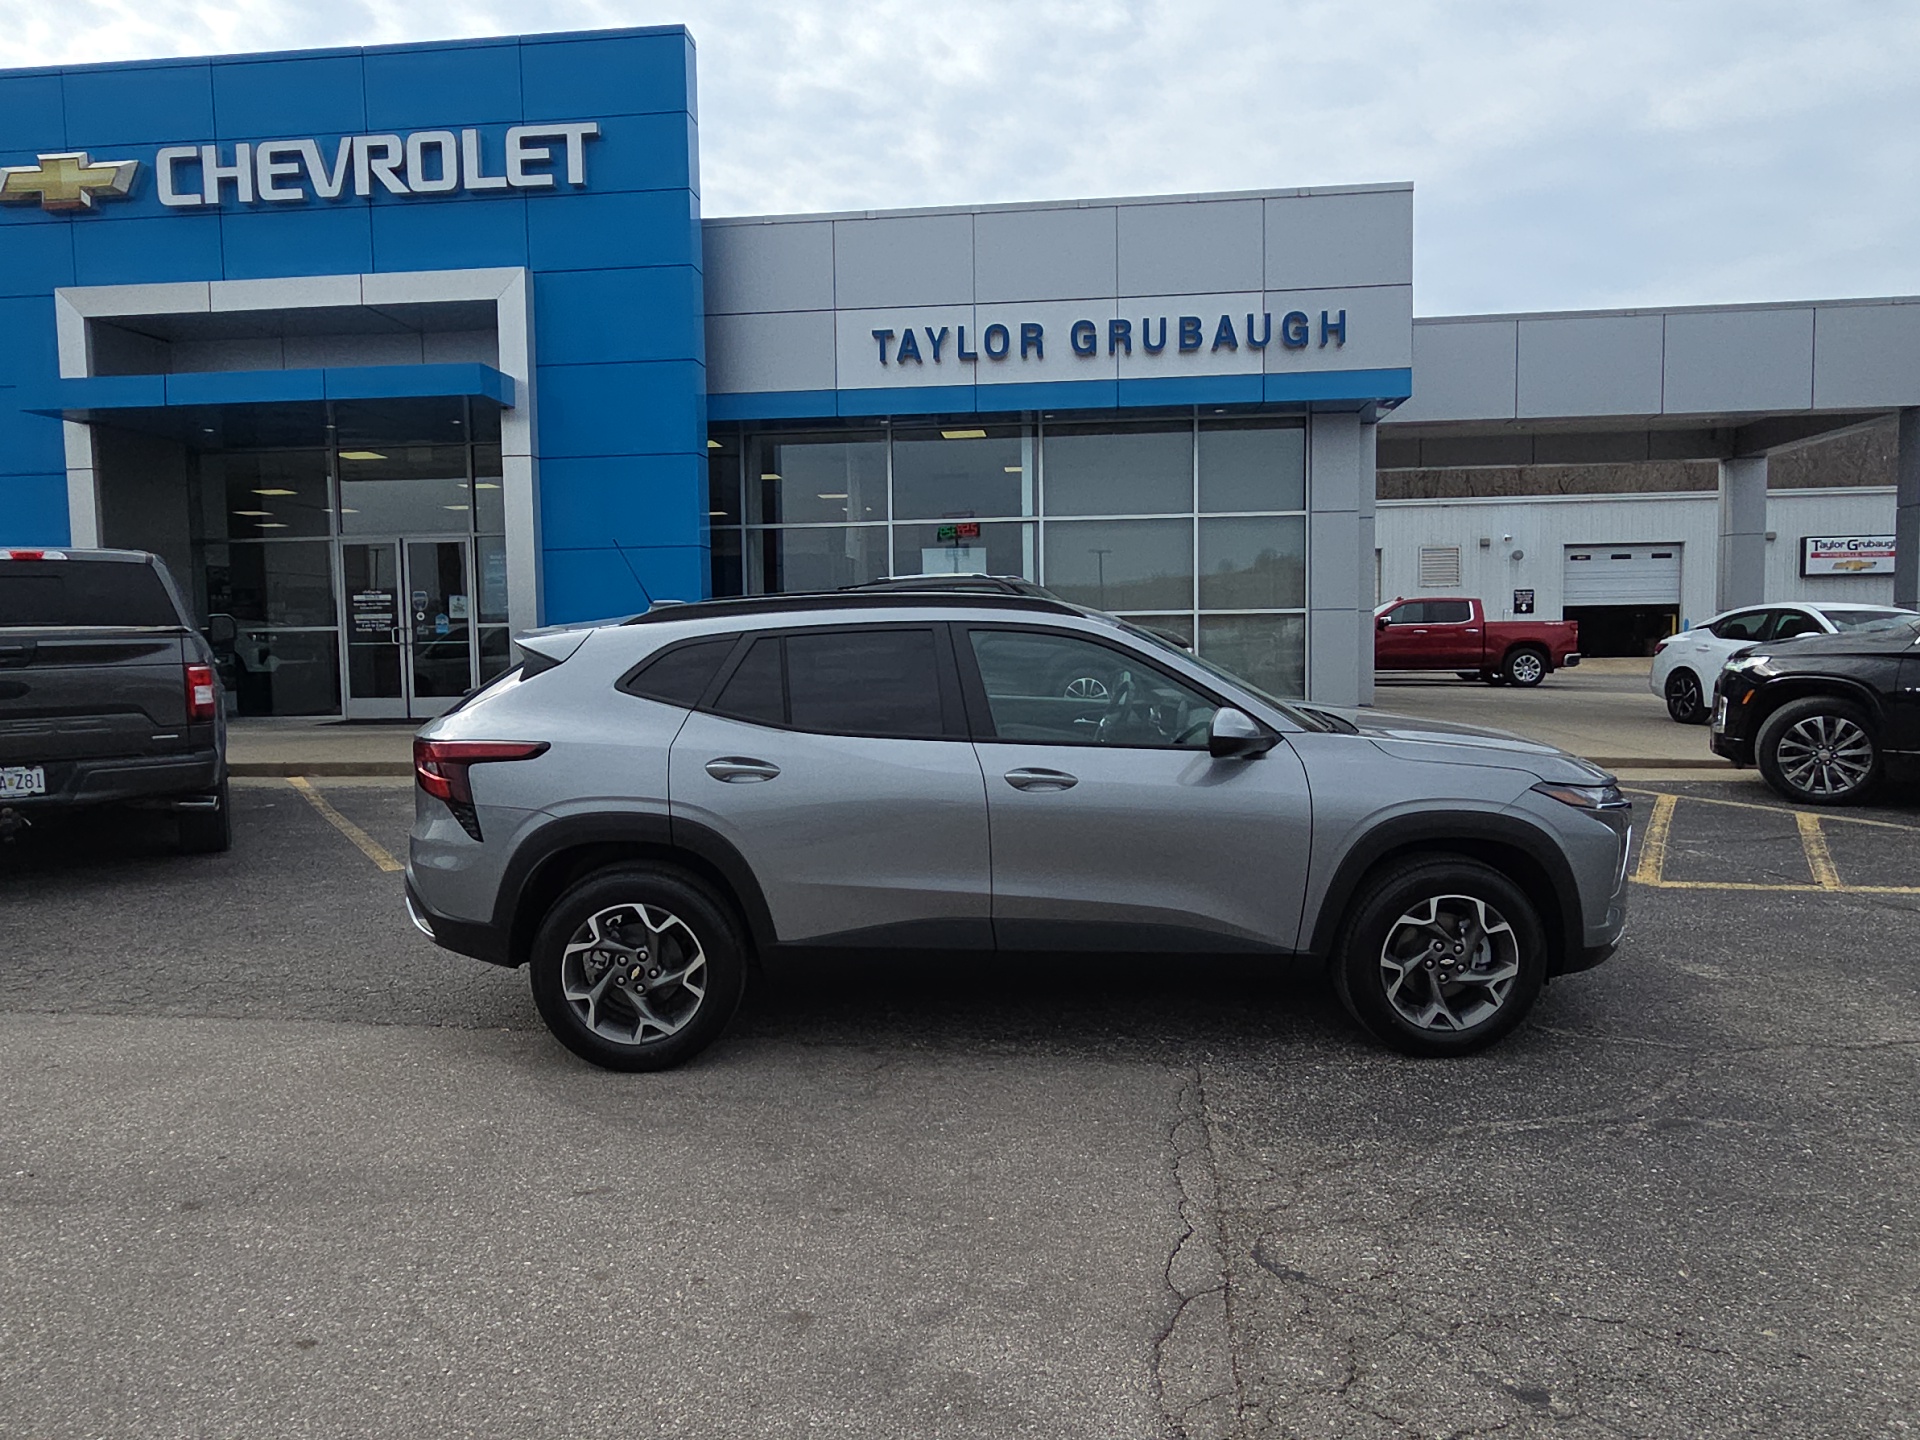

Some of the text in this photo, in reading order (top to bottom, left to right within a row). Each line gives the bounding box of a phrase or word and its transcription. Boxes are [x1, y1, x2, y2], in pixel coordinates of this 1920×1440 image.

[156, 121, 600, 207] CHEVROLET
[871, 308, 1347, 365] TAYLOR GRUBAUGH
[1811, 539, 1846, 552] Taylor
[14, 772, 43, 790] Z81
